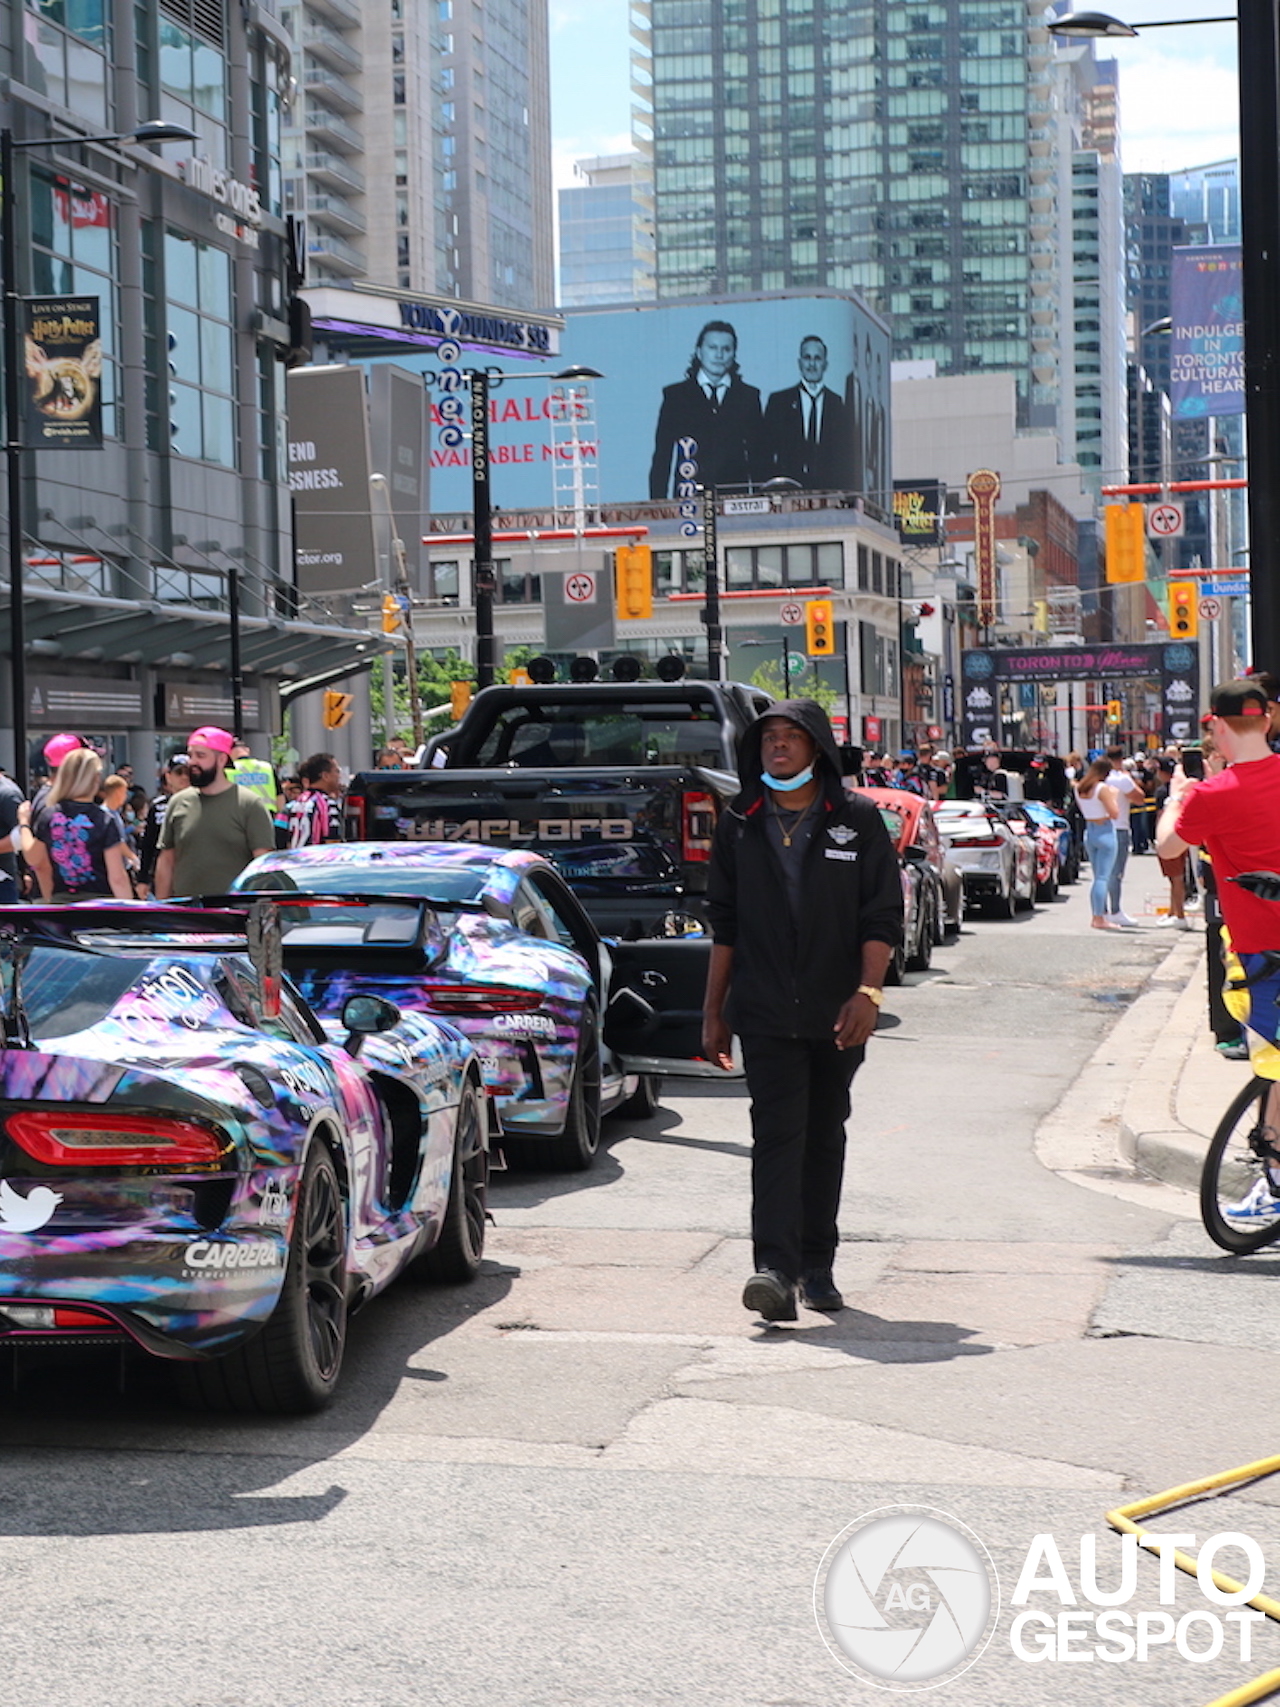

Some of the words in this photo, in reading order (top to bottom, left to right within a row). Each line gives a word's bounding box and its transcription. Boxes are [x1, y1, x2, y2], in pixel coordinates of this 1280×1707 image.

[32, 304, 51, 313] LIVE
[53, 303, 66, 312] ON
[460, 313, 524, 346] DUNDAS
[526, 325, 550, 350] SQ
[1176, 323, 1244, 340] INDULGE
[1204, 339, 1220, 351] IN
[1171, 366, 1245, 382] CULTURAL
[473, 381, 484, 481] DOWNTOWN
[429, 443, 535, 468] AVAIABLE
[730, 500, 764, 512] astral
[1007, 653, 1083, 669] TORONTO
[493, 1014, 557, 1034] CARRERA
[184, 1240, 277, 1269] CARRERA
